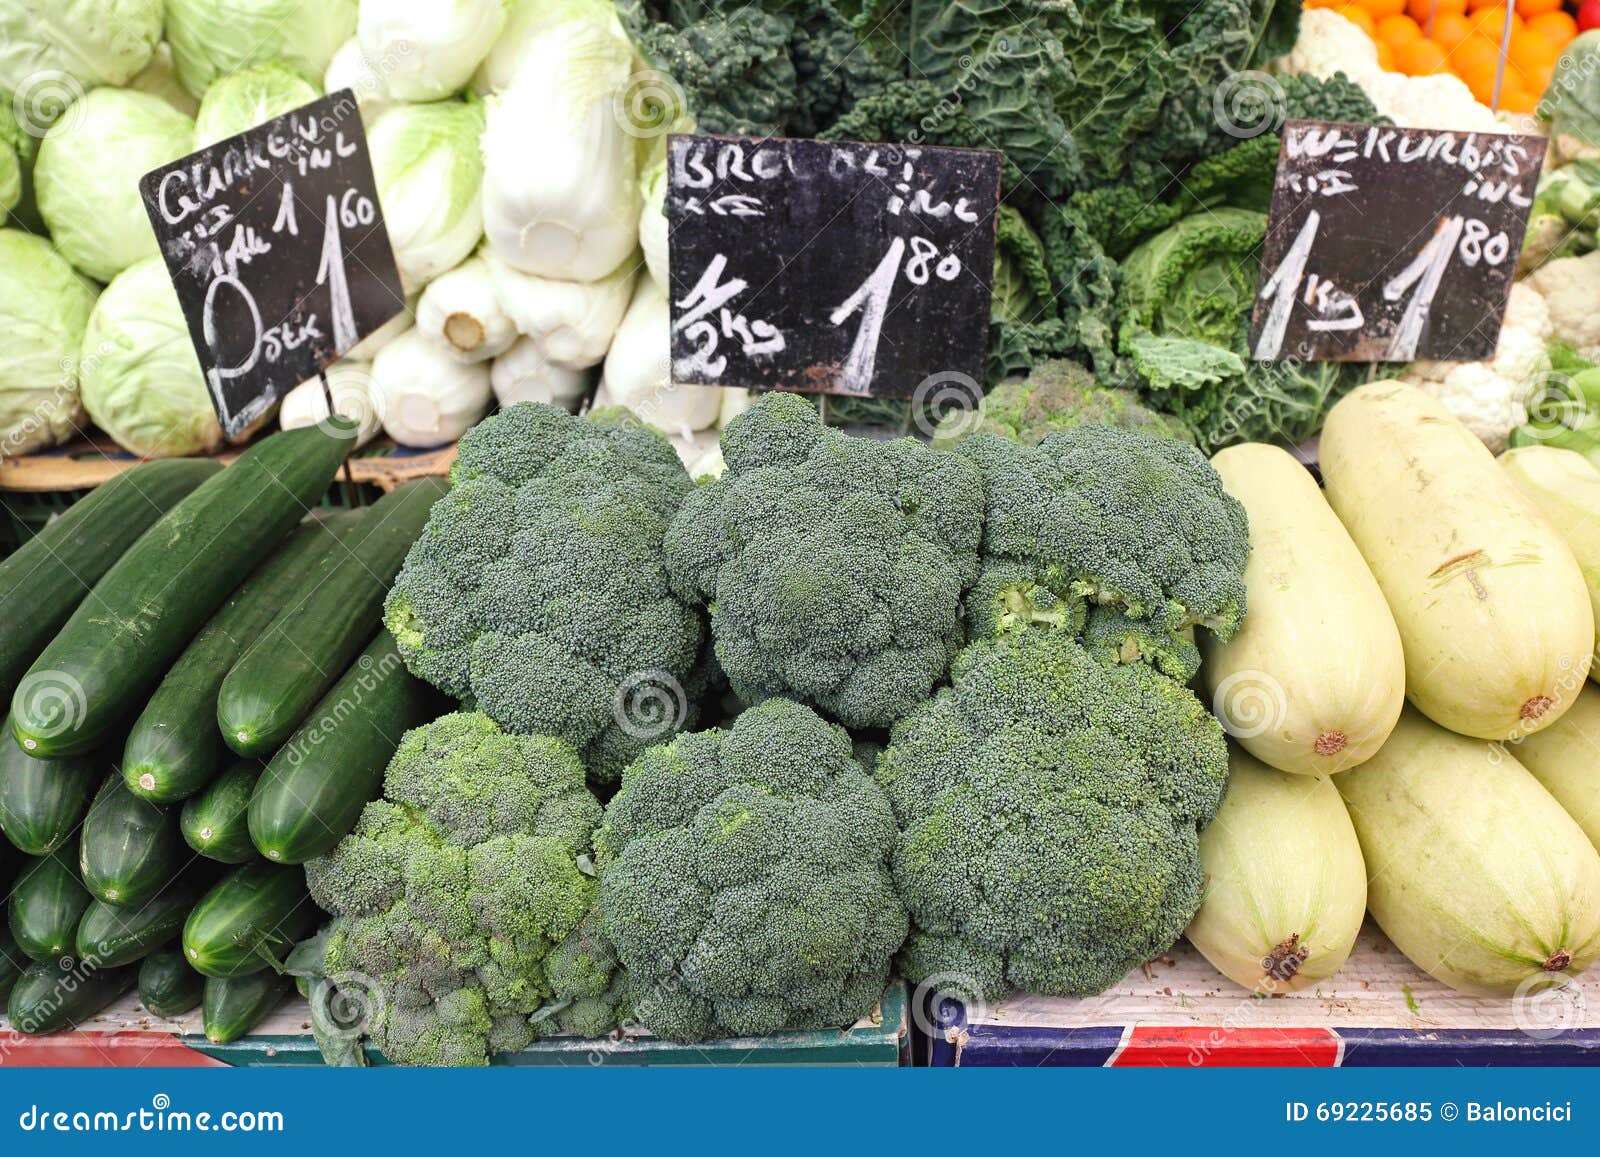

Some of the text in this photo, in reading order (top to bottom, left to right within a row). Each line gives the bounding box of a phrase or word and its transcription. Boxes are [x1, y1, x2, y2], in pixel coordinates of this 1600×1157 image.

[316, 194, 359, 358] 1
[341, 187, 375, 229] 60
[829, 236, 906, 397] 1
[906, 235, 962, 286] 80
[1253, 208, 1320, 361] 1
[1383, 214, 1465, 361] 1
[1459, 218, 1510, 267] 80
